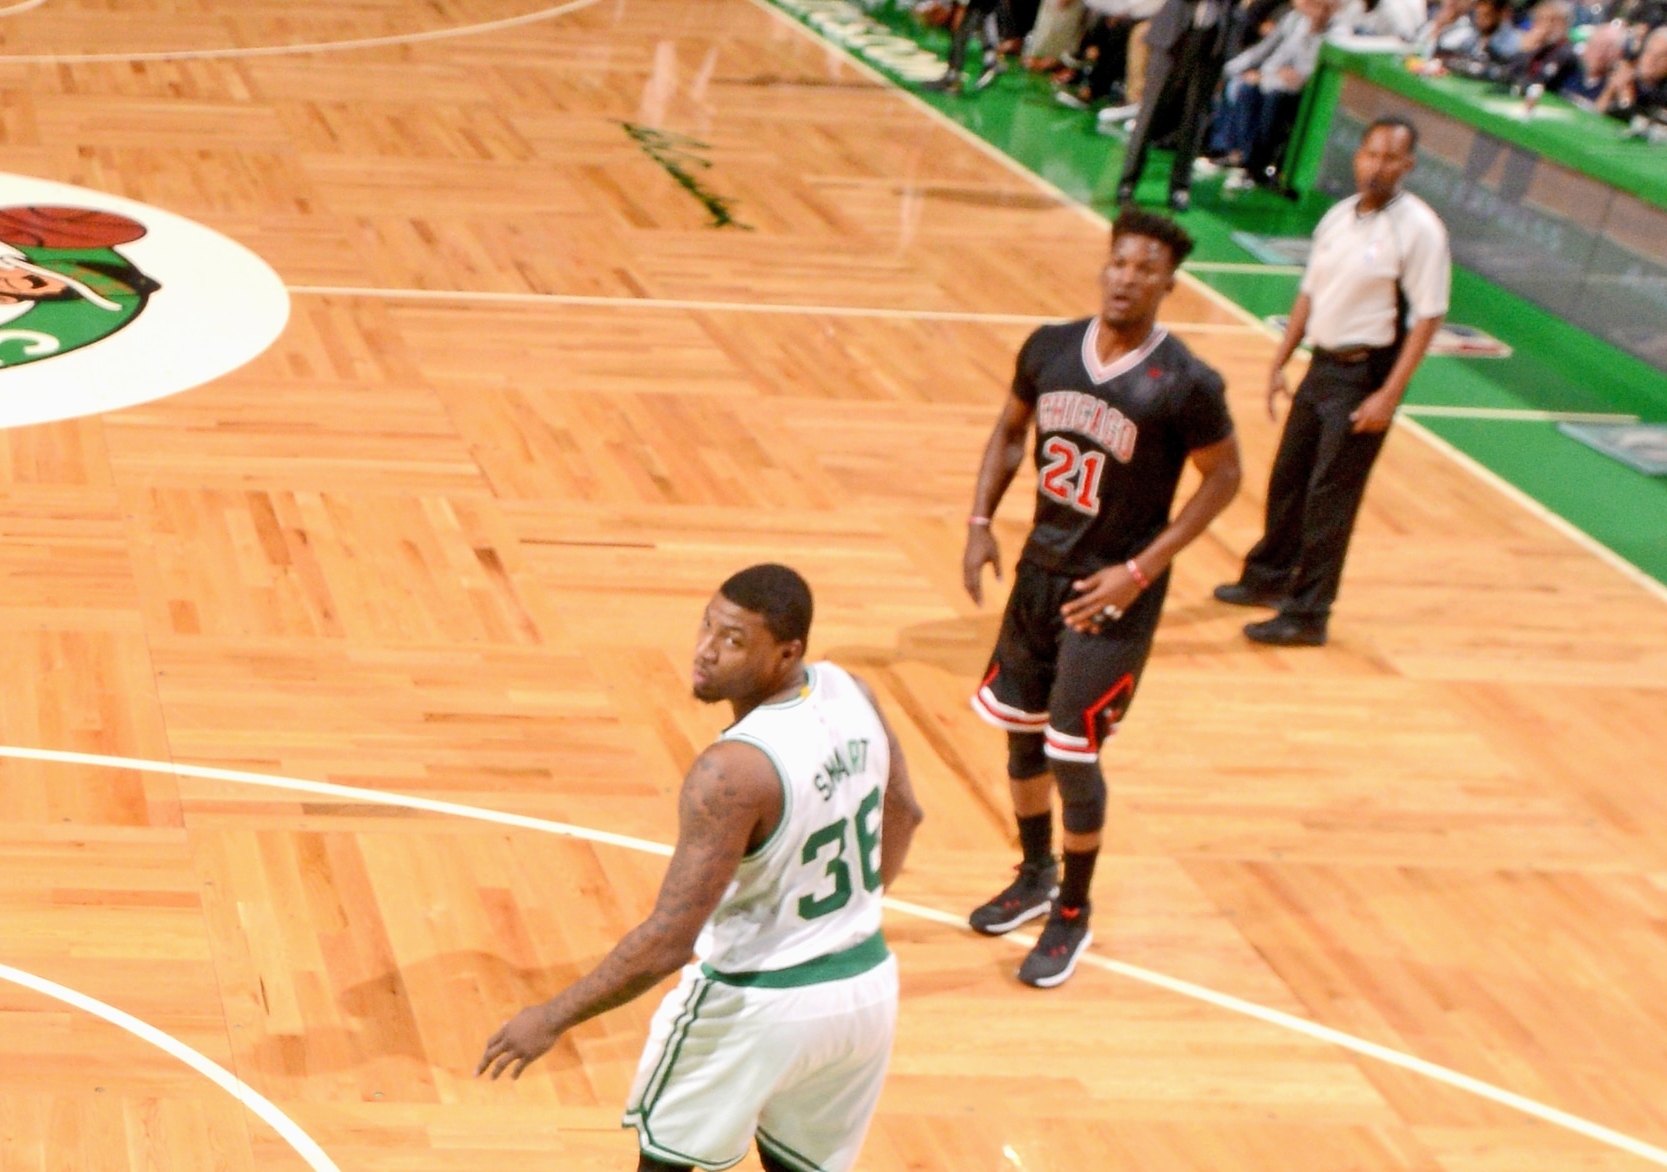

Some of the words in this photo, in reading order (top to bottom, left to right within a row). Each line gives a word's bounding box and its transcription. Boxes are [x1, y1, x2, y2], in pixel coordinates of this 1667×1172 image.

[1037, 390, 1138, 464] CHICAGO
[1039, 436, 1106, 516] 21
[814, 739, 868, 801] SMART
